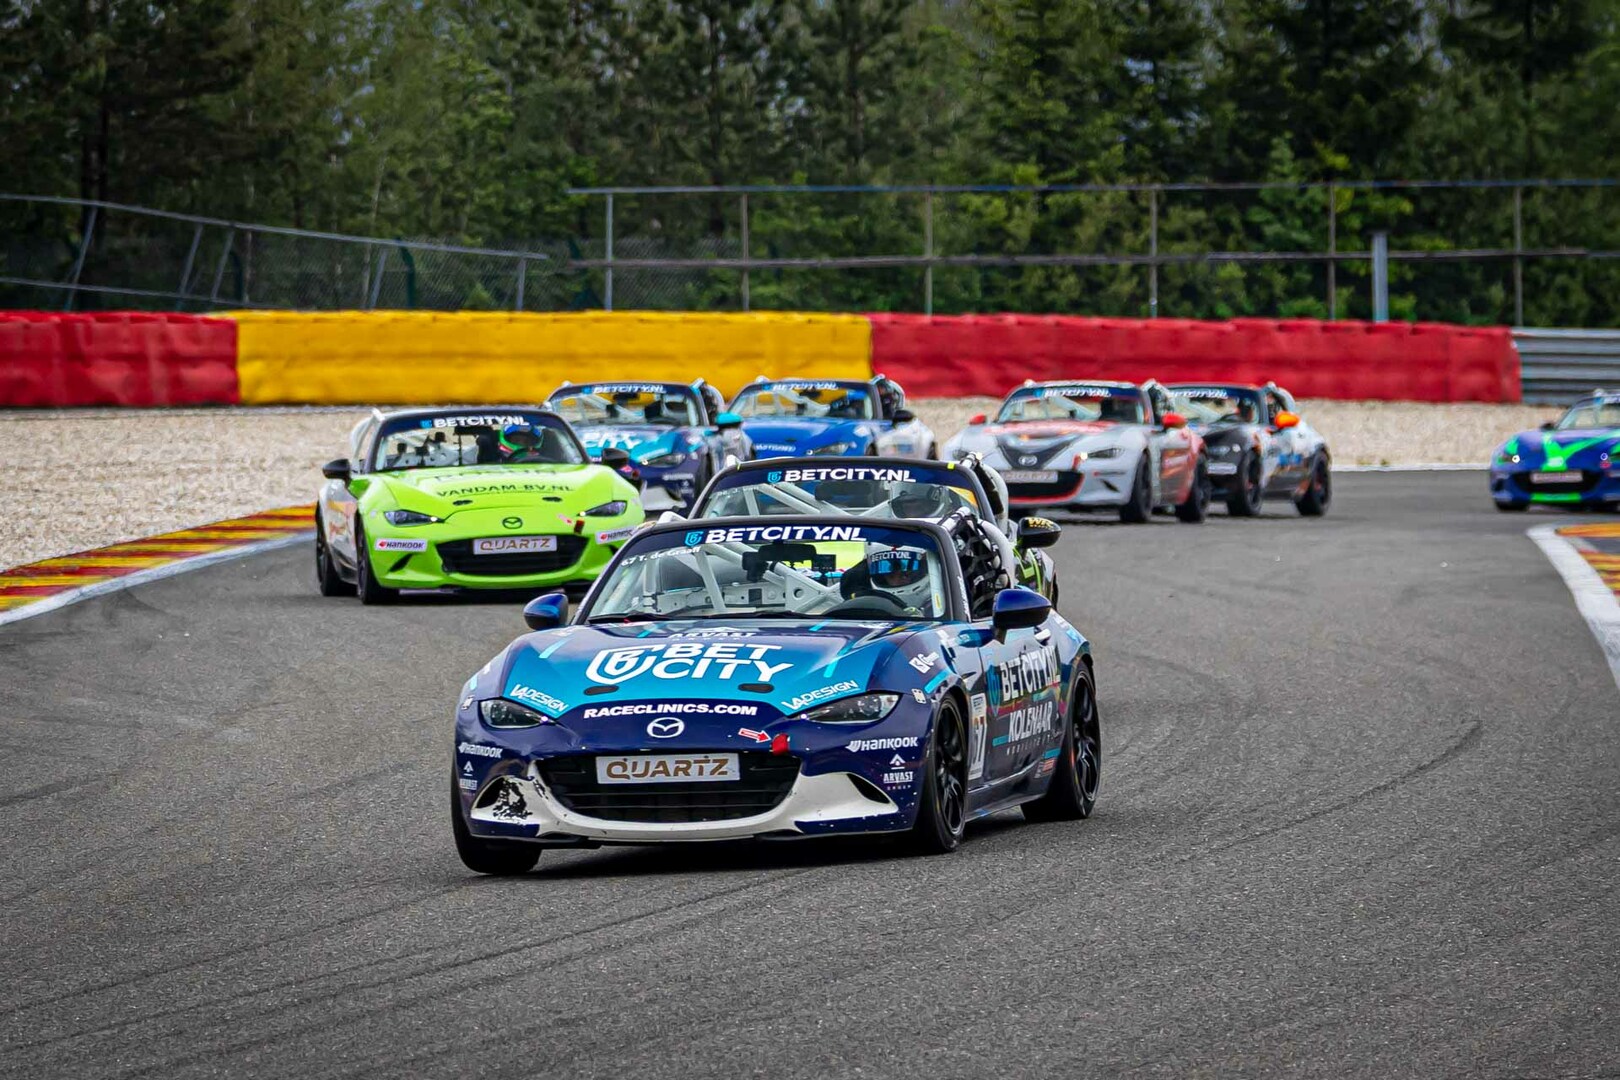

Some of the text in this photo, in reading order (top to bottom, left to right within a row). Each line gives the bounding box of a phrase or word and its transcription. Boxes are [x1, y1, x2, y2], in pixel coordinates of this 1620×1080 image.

[433, 415, 530, 428] BETCITY.NL
[785, 468, 916, 483] BETCITY.NL
[705, 526, 867, 544] BETCITY.NL
[480, 538, 551, 551] QUARTZ
[871, 550, 911, 562] BETCITY.NL
[662, 642, 782, 660] BET
[652, 658, 794, 682] CITY
[1000, 645, 1061, 702] BETCITY.NL
[583, 703, 758, 719] RACECLINICS.COM
[606, 758, 729, 780] QUARTZ
[883, 771, 913, 784] ARVAST
